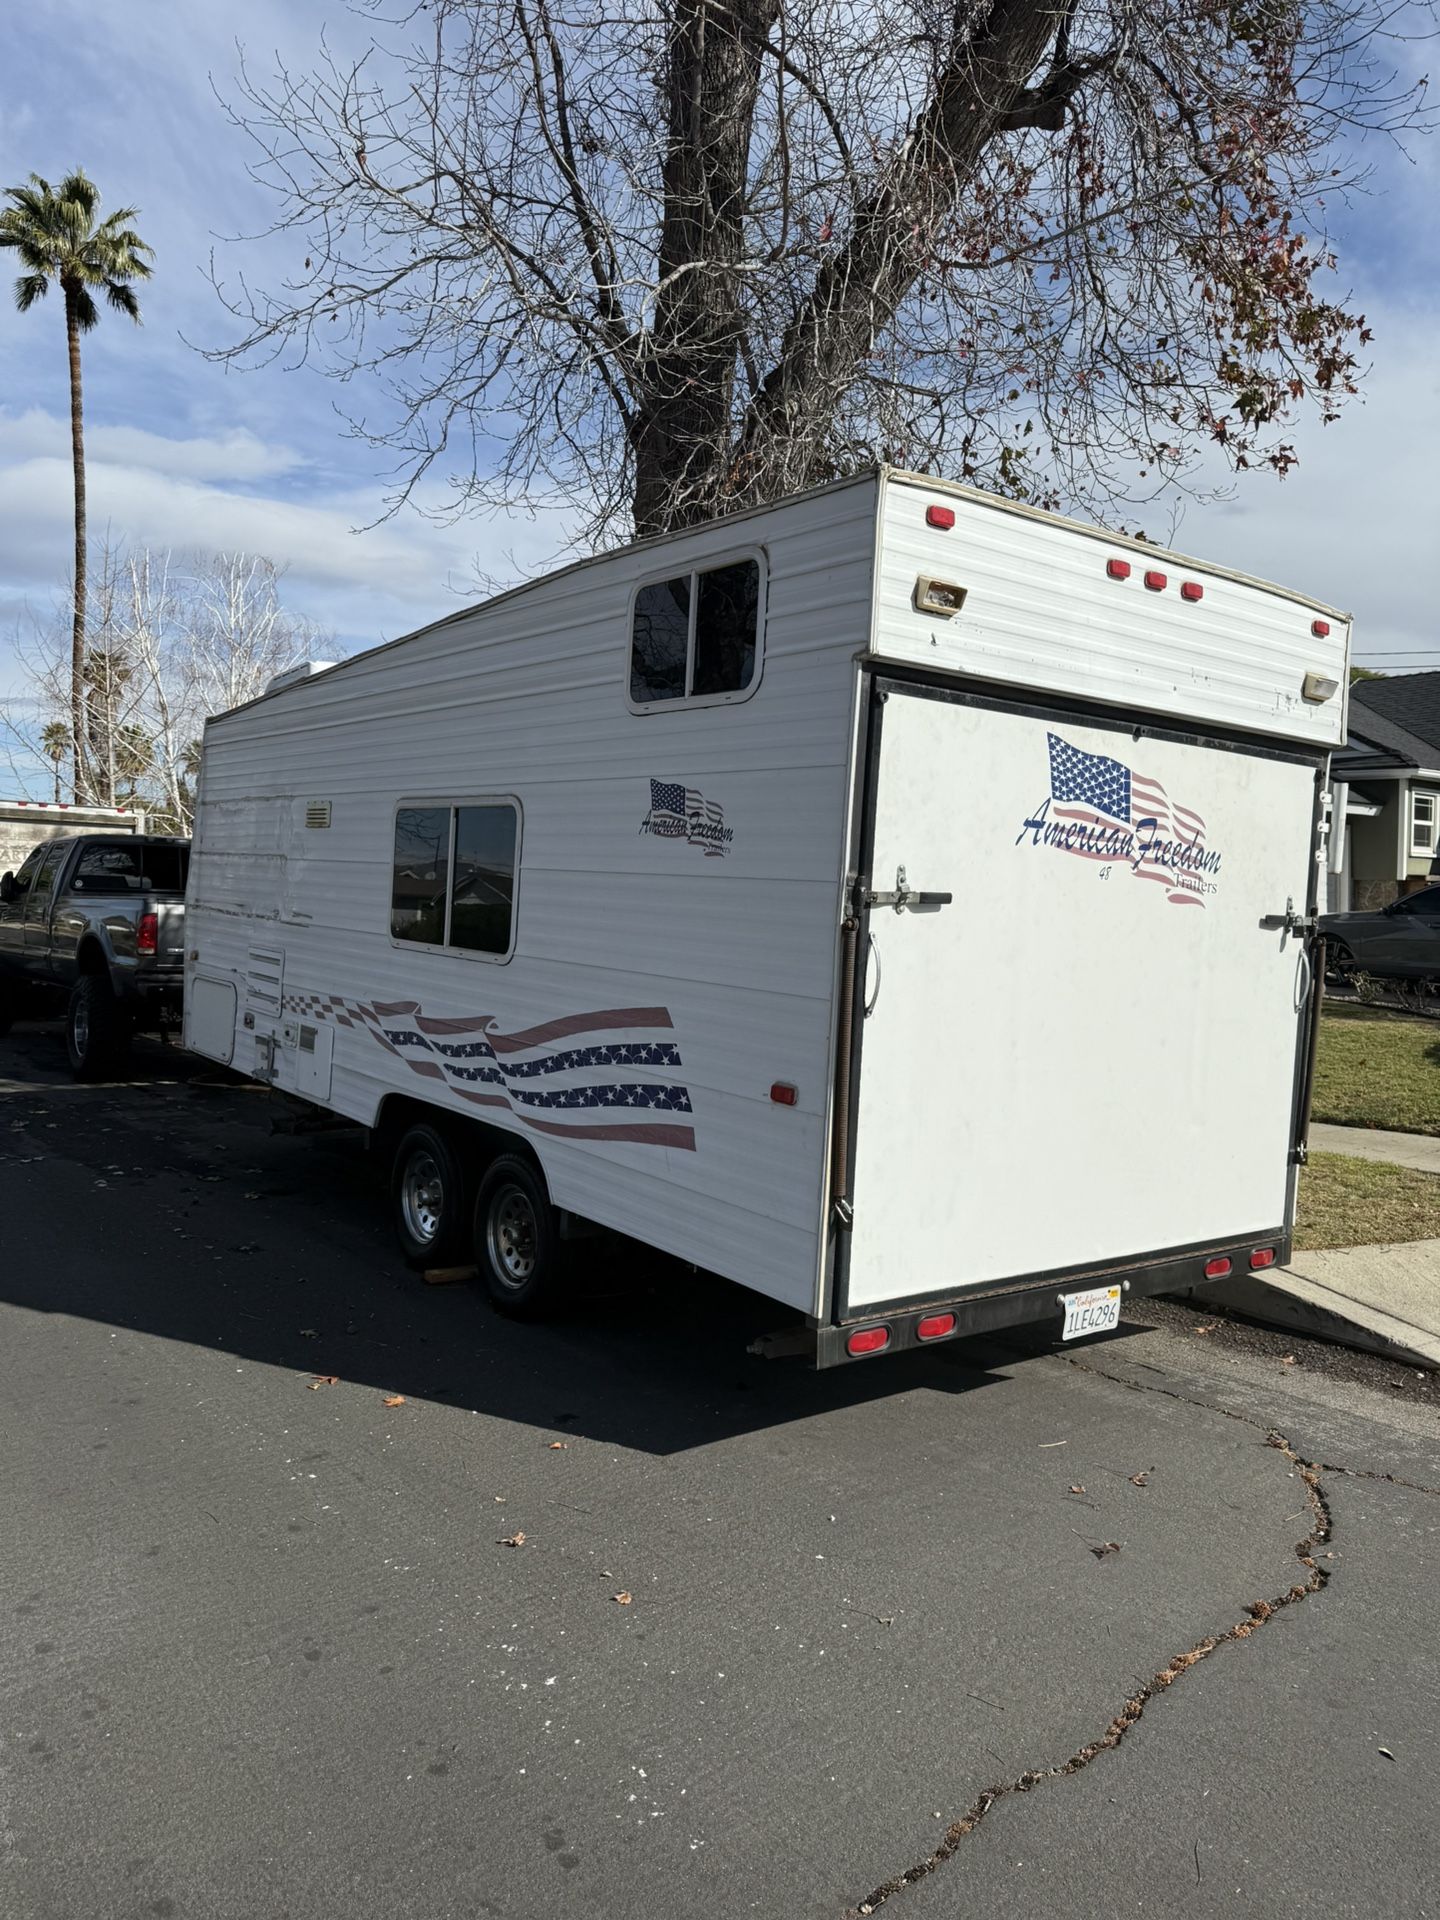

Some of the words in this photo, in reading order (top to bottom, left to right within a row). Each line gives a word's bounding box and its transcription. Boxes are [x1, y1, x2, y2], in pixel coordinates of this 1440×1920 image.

[1015, 797, 1134, 857] American
[1131, 818, 1222, 874] Freedom
[1173, 873, 1218, 894] Trailers
[1067, 1303, 1117, 1333] 1LE4296
